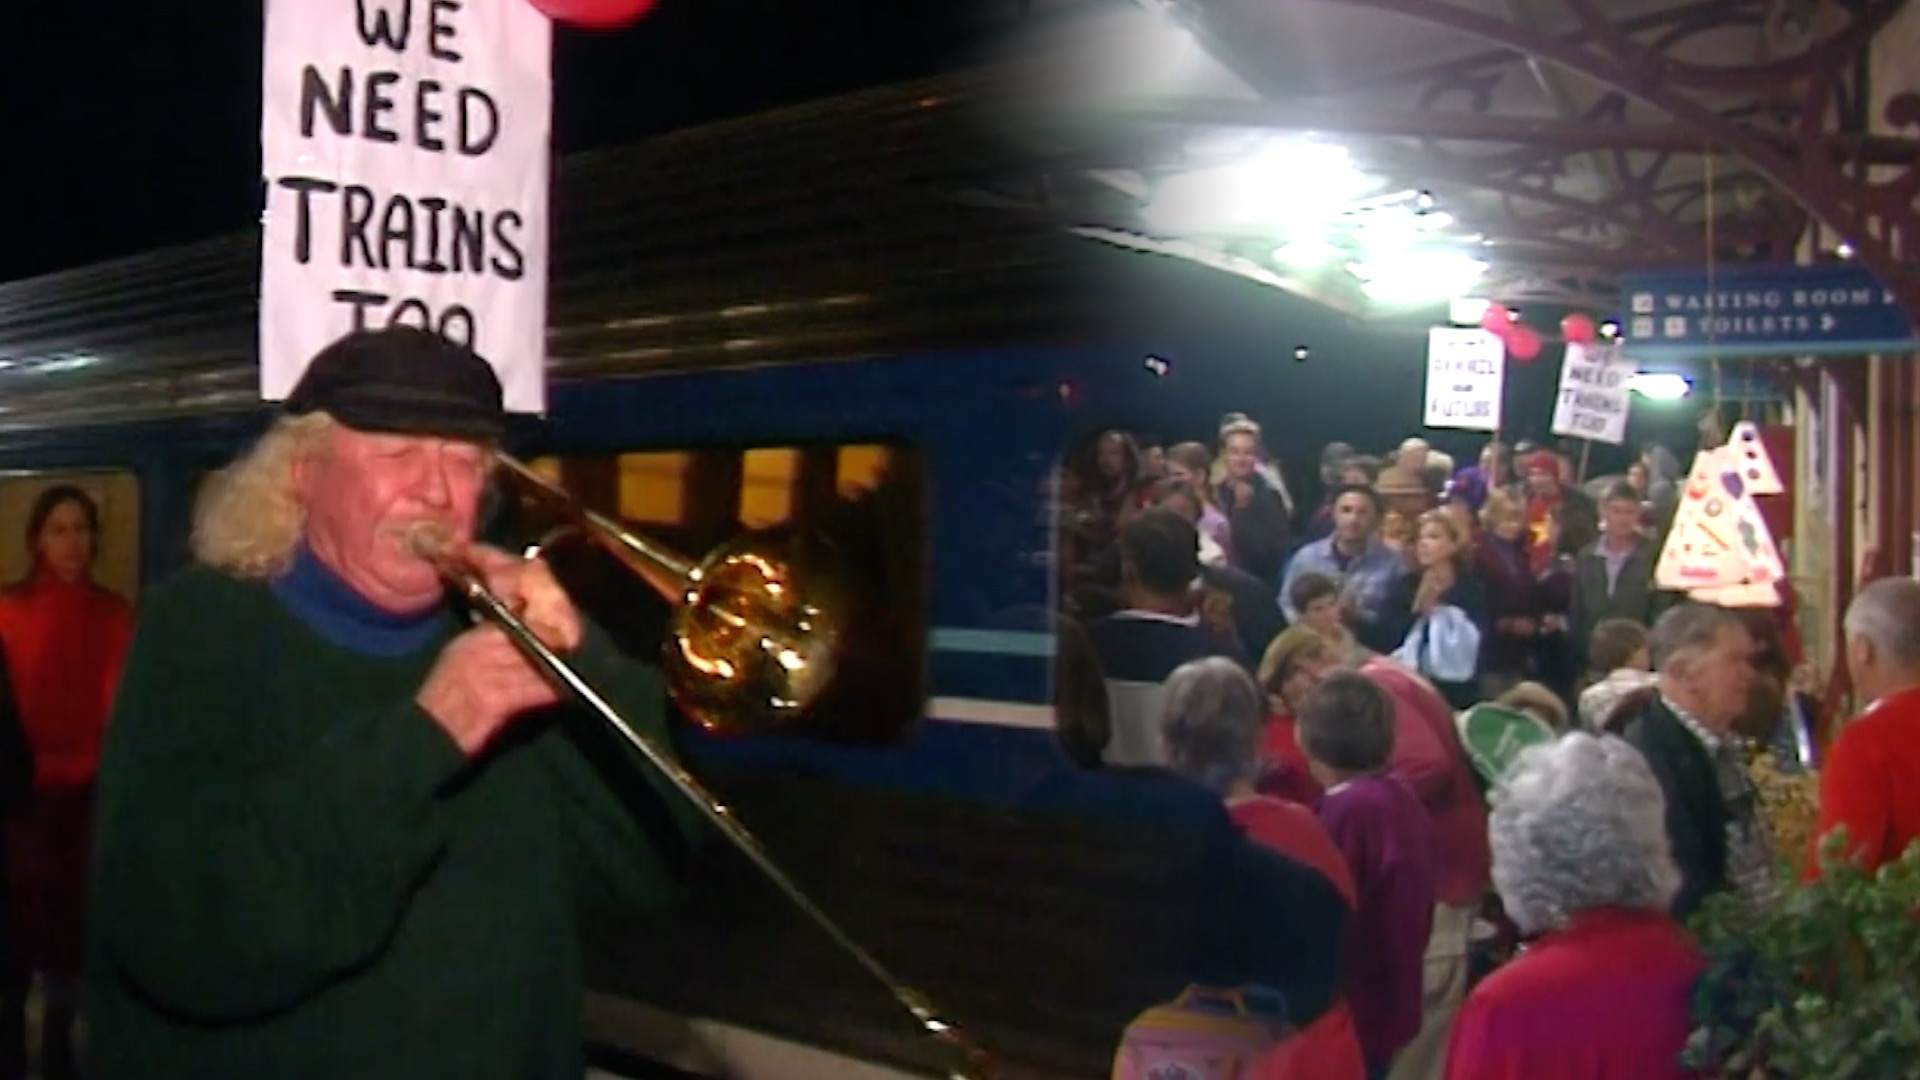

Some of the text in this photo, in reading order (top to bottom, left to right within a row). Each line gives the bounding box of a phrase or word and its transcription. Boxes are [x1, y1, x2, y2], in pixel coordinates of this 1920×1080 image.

[356, 0, 462, 62] WE
[301, 63, 500, 156] NEED
[278, 175, 524, 280] TRAINS
[1665, 288, 1871, 309] WAITING ROOM
[1700, 316, 1810, 334] TOILETS
